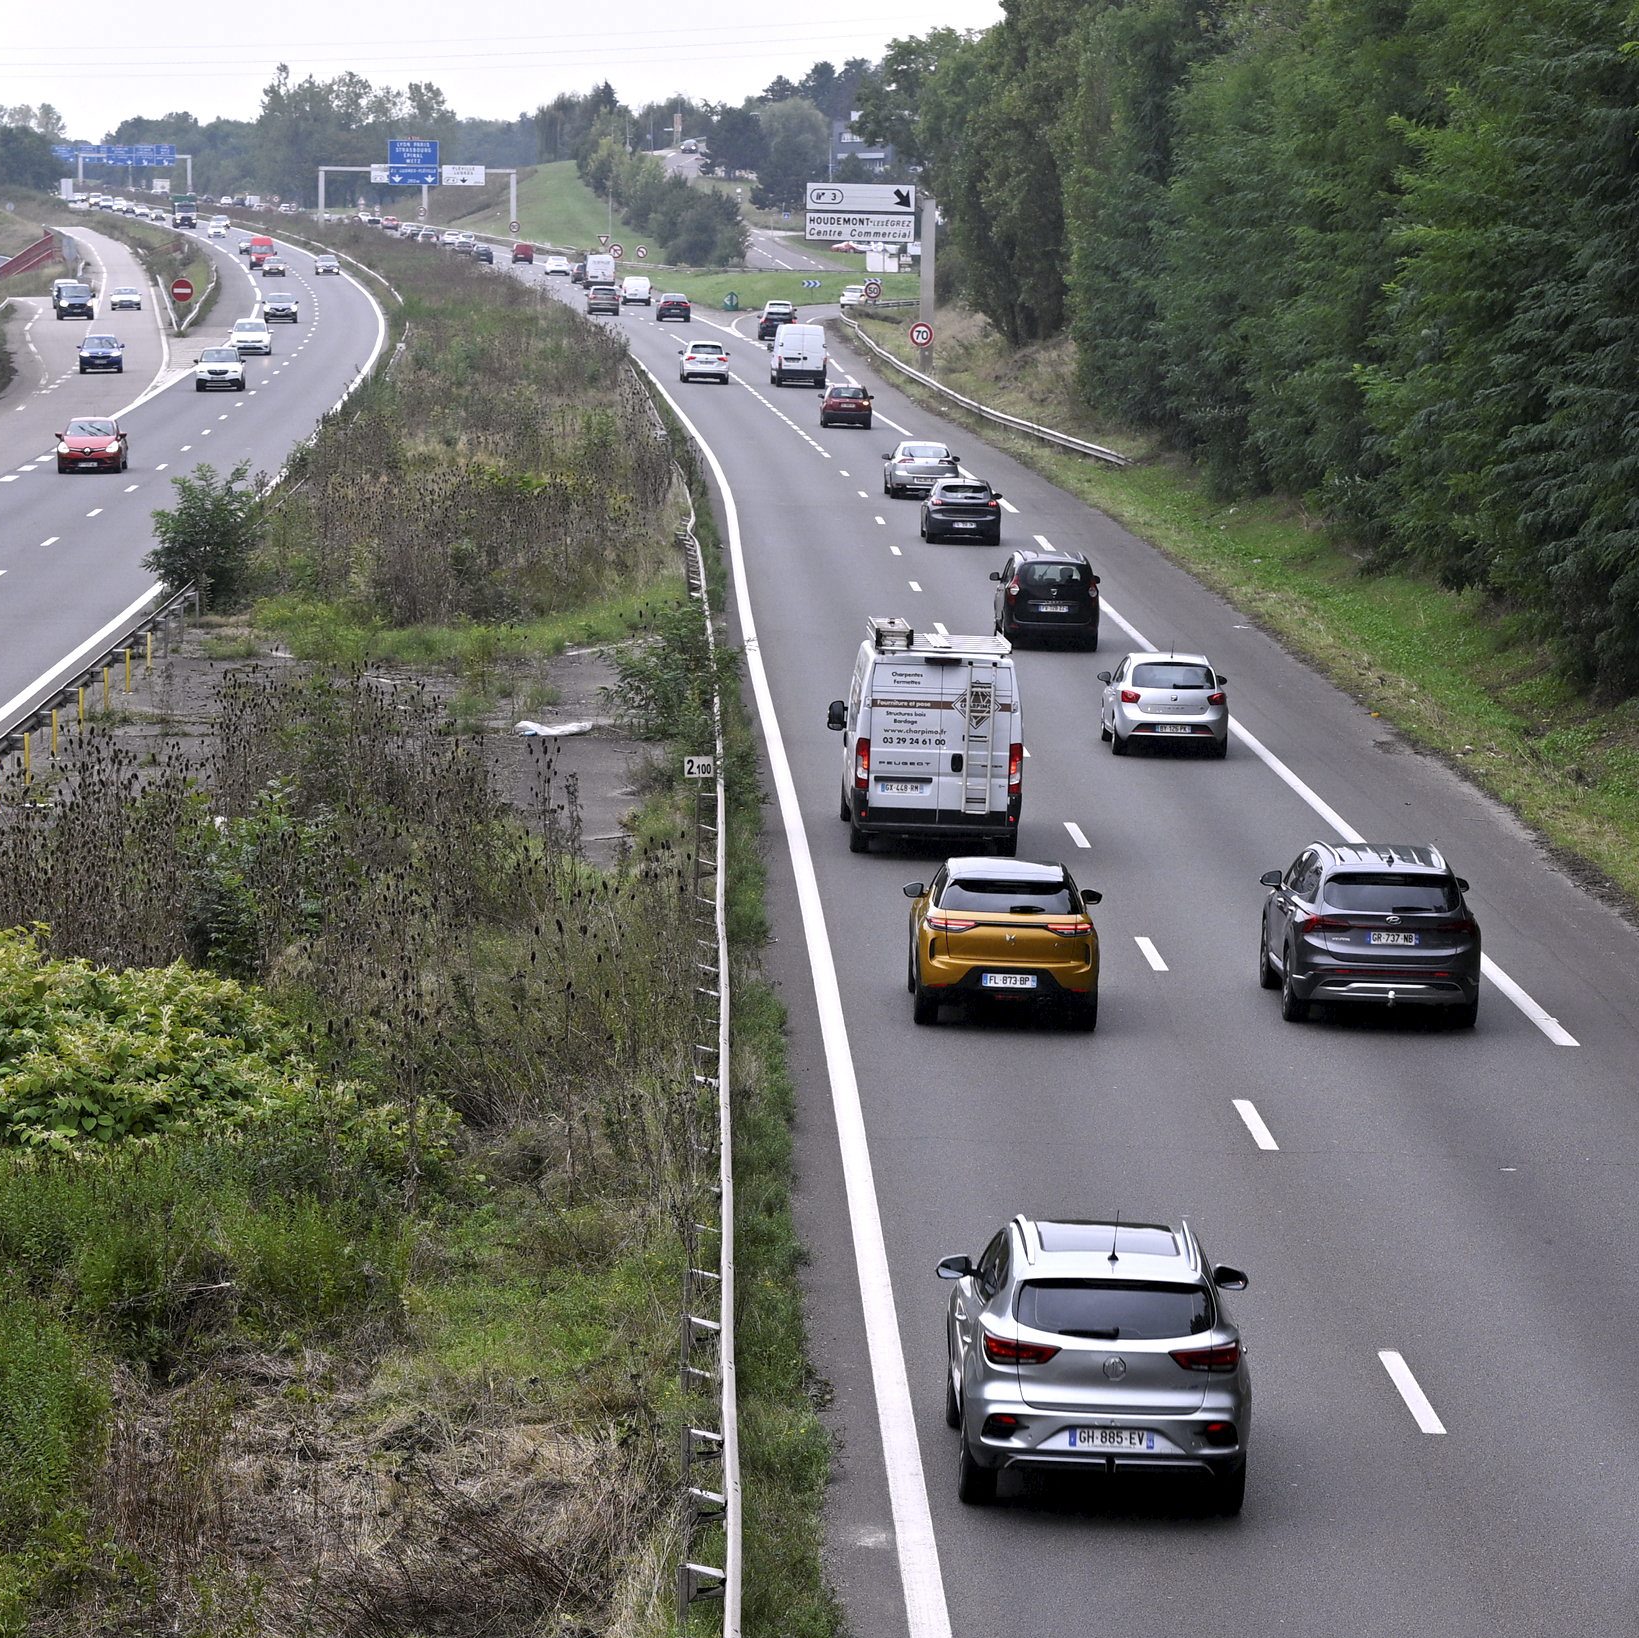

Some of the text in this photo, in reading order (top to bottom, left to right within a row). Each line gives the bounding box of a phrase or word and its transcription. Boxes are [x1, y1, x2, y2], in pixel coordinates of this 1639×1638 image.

[809, 228, 911, 238] Centre Commercial
[915, 330, 928, 340] 70
[687, 759, 711, 775] 2.100
[1372, 933, 1413, 944] GR-737-NB
[1079, 1430, 1144, 1445] GH-885-EV
